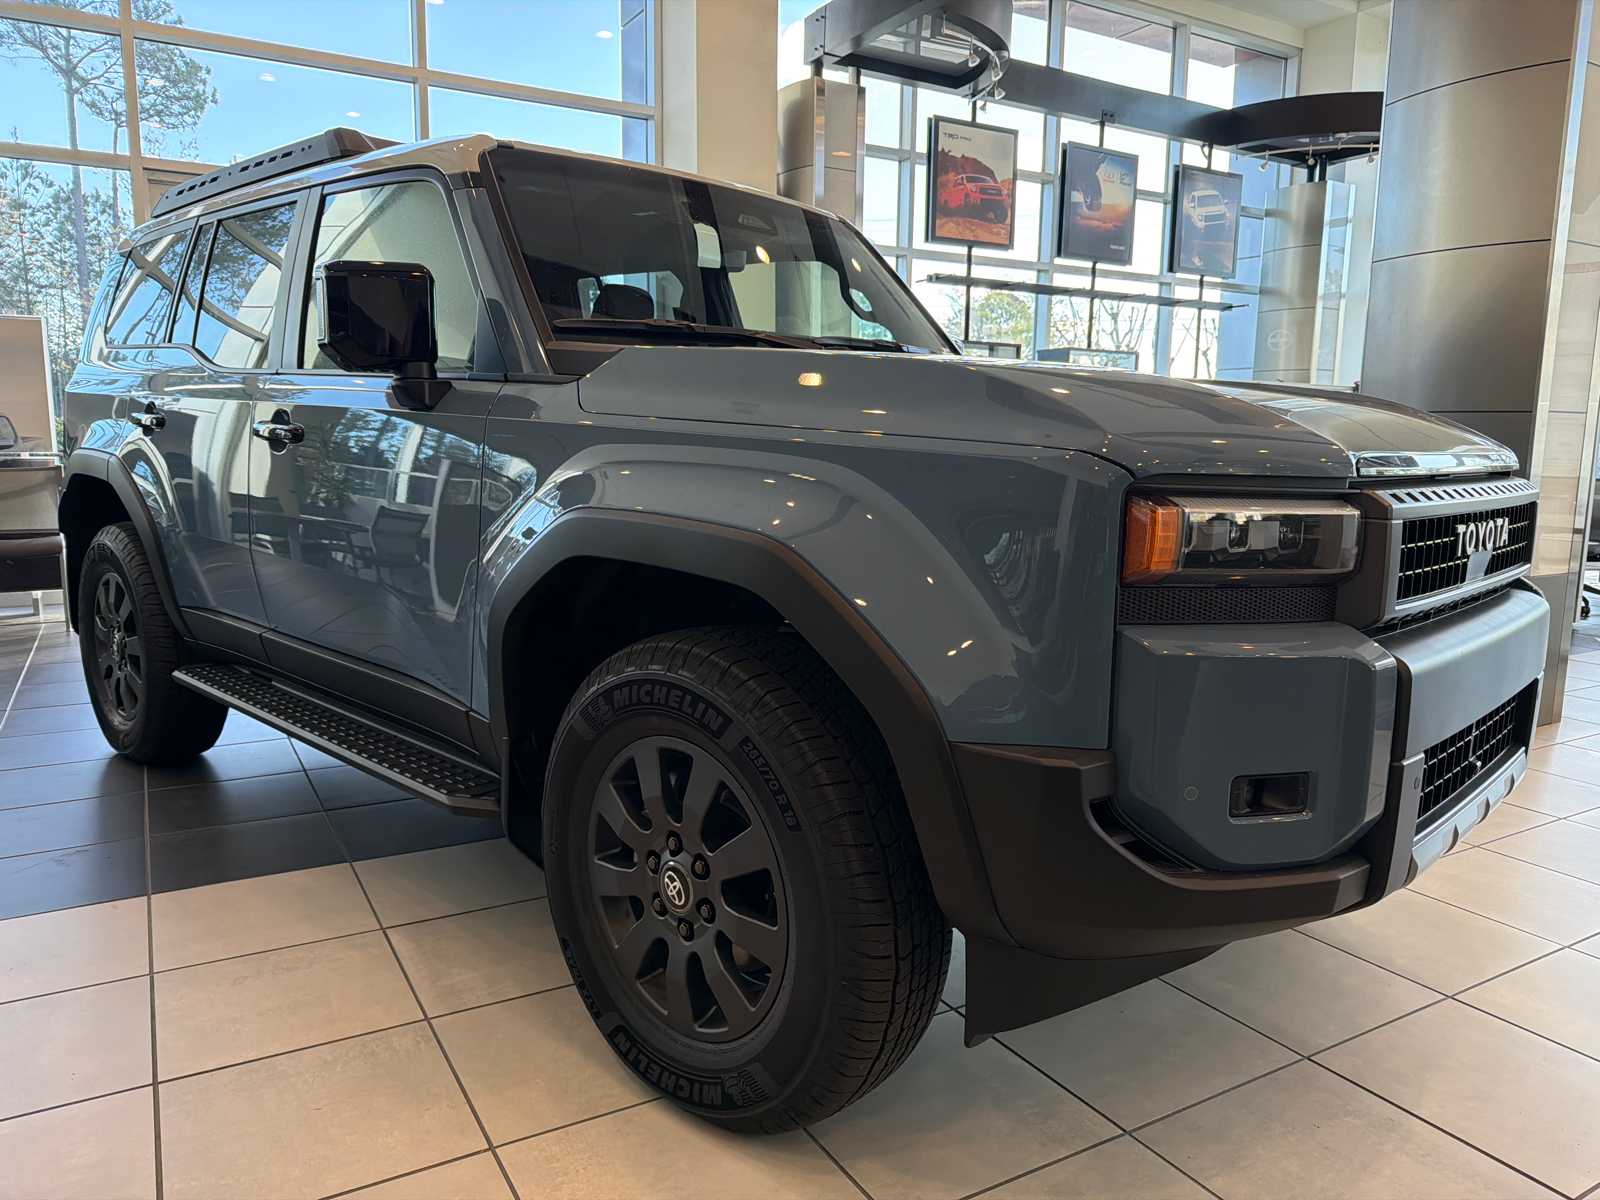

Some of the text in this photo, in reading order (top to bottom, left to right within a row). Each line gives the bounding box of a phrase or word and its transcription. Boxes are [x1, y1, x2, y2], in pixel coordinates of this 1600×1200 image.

[942, 131, 959, 140] TRD
[1455, 517, 1509, 557] TOYOTA
[612, 684, 724, 732] MICHELIN
[742, 741, 798, 827] 265/70 R 18
[612, 1031, 723, 1106] MICHELIN
